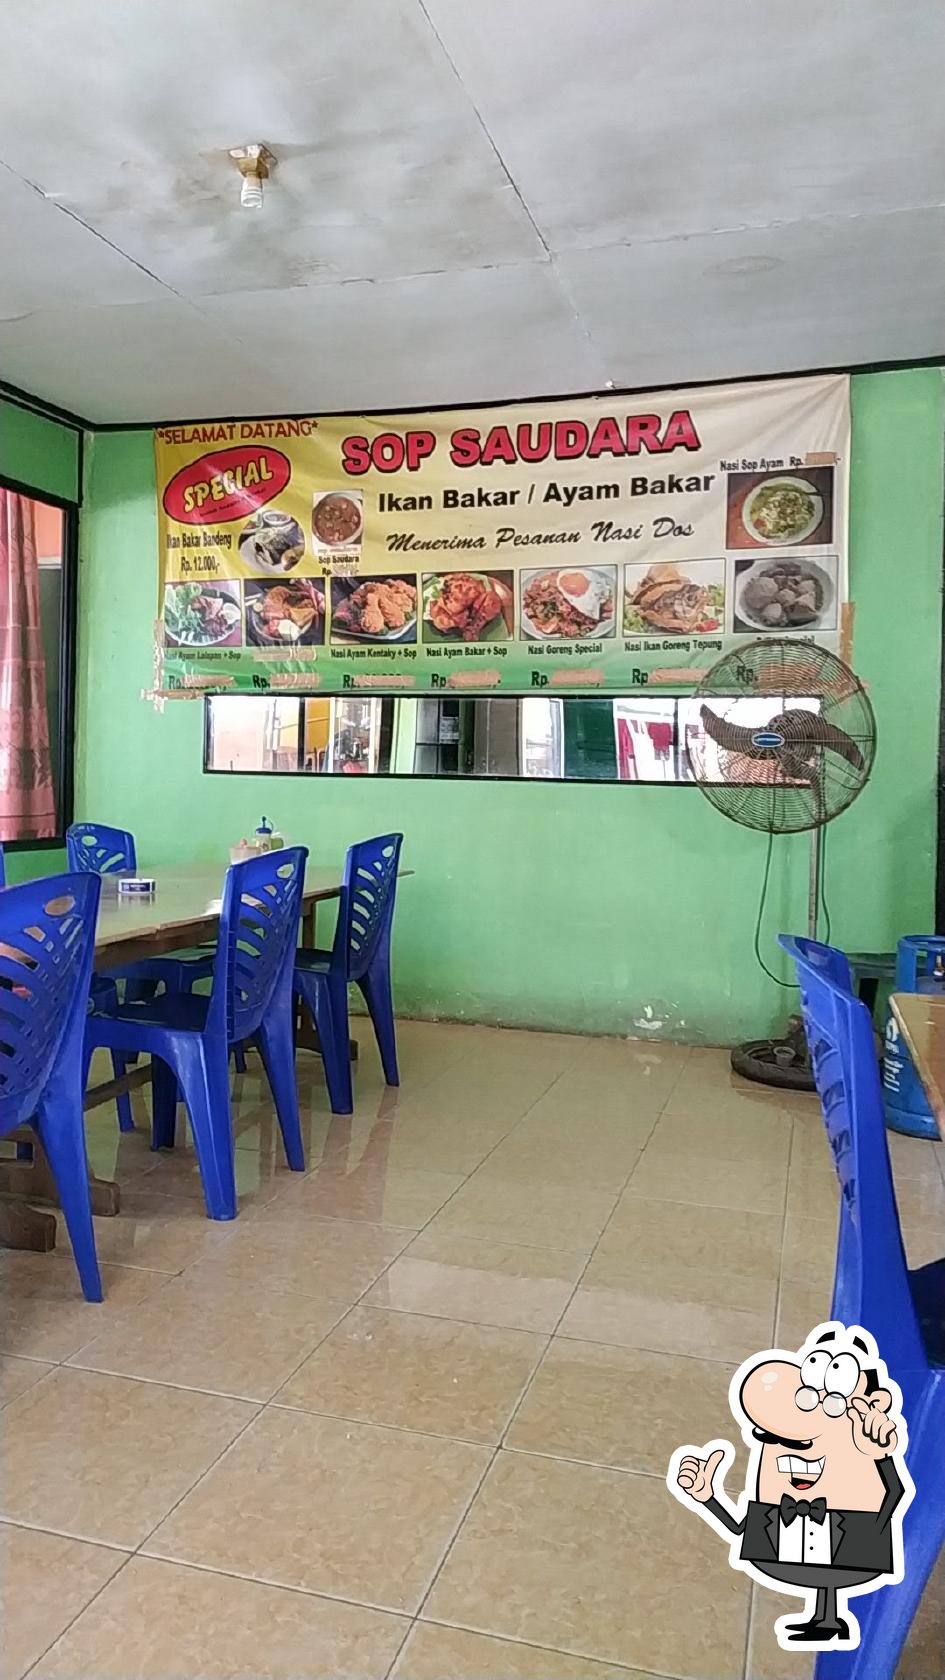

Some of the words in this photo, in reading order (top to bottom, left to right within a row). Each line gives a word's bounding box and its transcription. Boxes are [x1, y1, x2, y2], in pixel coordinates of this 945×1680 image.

[341, 431, 437, 475] SOP
[449, 410, 702, 468] SAUDARA
[720, 460, 739, 471] Nasi
[741, 458, 758, 472] Sop
[760, 458, 785, 471] Ayam
[183, 456, 273, 513] SPECIAL
[379, 493, 433, 512] Ikan
[442, 487, 521, 509] Bakar
[527, 483, 536, 505] /
[542, 482, 620, 507] Ayam
[630, 474, 716, 497] Bakar
[182, 532, 201, 548] Bakar
[203, 530, 232, 550] Bandeng
[386, 532, 487, 551] Menerima
[496, 527, 582, 549] Pesanan
[591, 520, 643, 543] Nasi
[652, 516, 695, 538] Dos
[181, 556, 192, 576] Rp.
[331, 649, 345, 658] Nasi
[347, 649, 366, 660] Ayam
[367, 647, 396, 660] Kentaky
[403, 649, 417, 660] Sop
[426, 647, 442, 657] Nasi
[443, 647, 463, 658] Ayam
[464, 647, 486, 656] Bakar
[493, 645, 508, 656] Sop
[528, 644, 545, 655] Nasi
[546, 643, 573, 655] Goreng
[574, 642, 602, 655] Special
[624, 641, 642, 651] Nasi
[643, 641, 661, 650] Ikan
[662, 640, 690, 652] Goreng
[692, 638, 722, 650] Tepung
